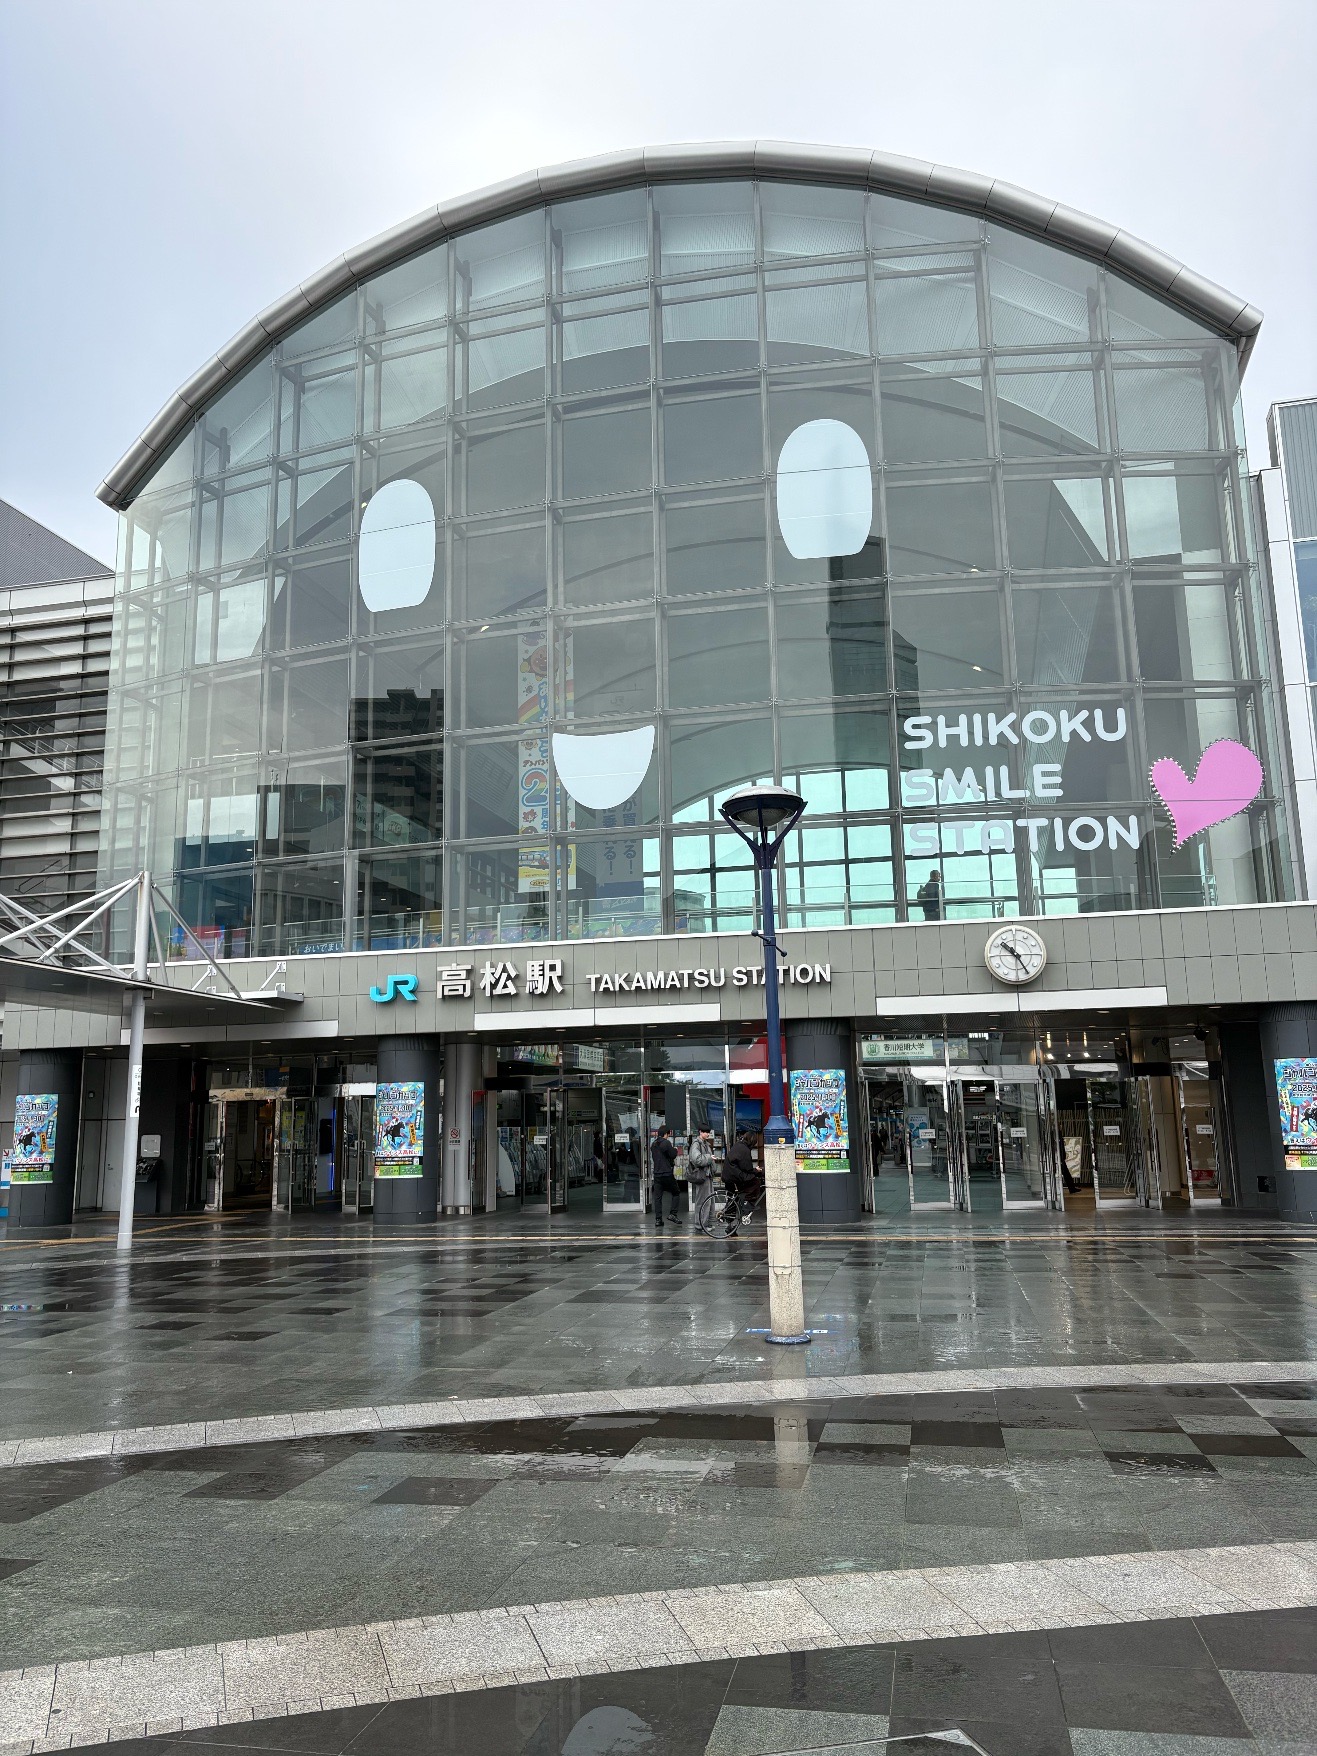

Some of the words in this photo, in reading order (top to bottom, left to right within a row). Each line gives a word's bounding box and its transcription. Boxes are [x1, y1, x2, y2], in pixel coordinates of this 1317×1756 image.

[904, 707, 1127, 750] SHIKOKU
[904, 763, 1064, 803] SMILE
[622, 797, 640, 875] が買る！
[909, 814, 1141, 857] STATION
[303, 942, 346, 954] おいでまい
[369, 974, 419, 1004] JR
[436, 959, 564, 999] 高松駅
[586, 966, 727, 993] TAKAMATSU
[732, 963, 832, 987] STTION
[884, 1042, 925, 1052] 香川短期大学
[1283, 1067, 1317, 1079] ジャパン
[1292, 1084, 1317, 1092] 2025.
